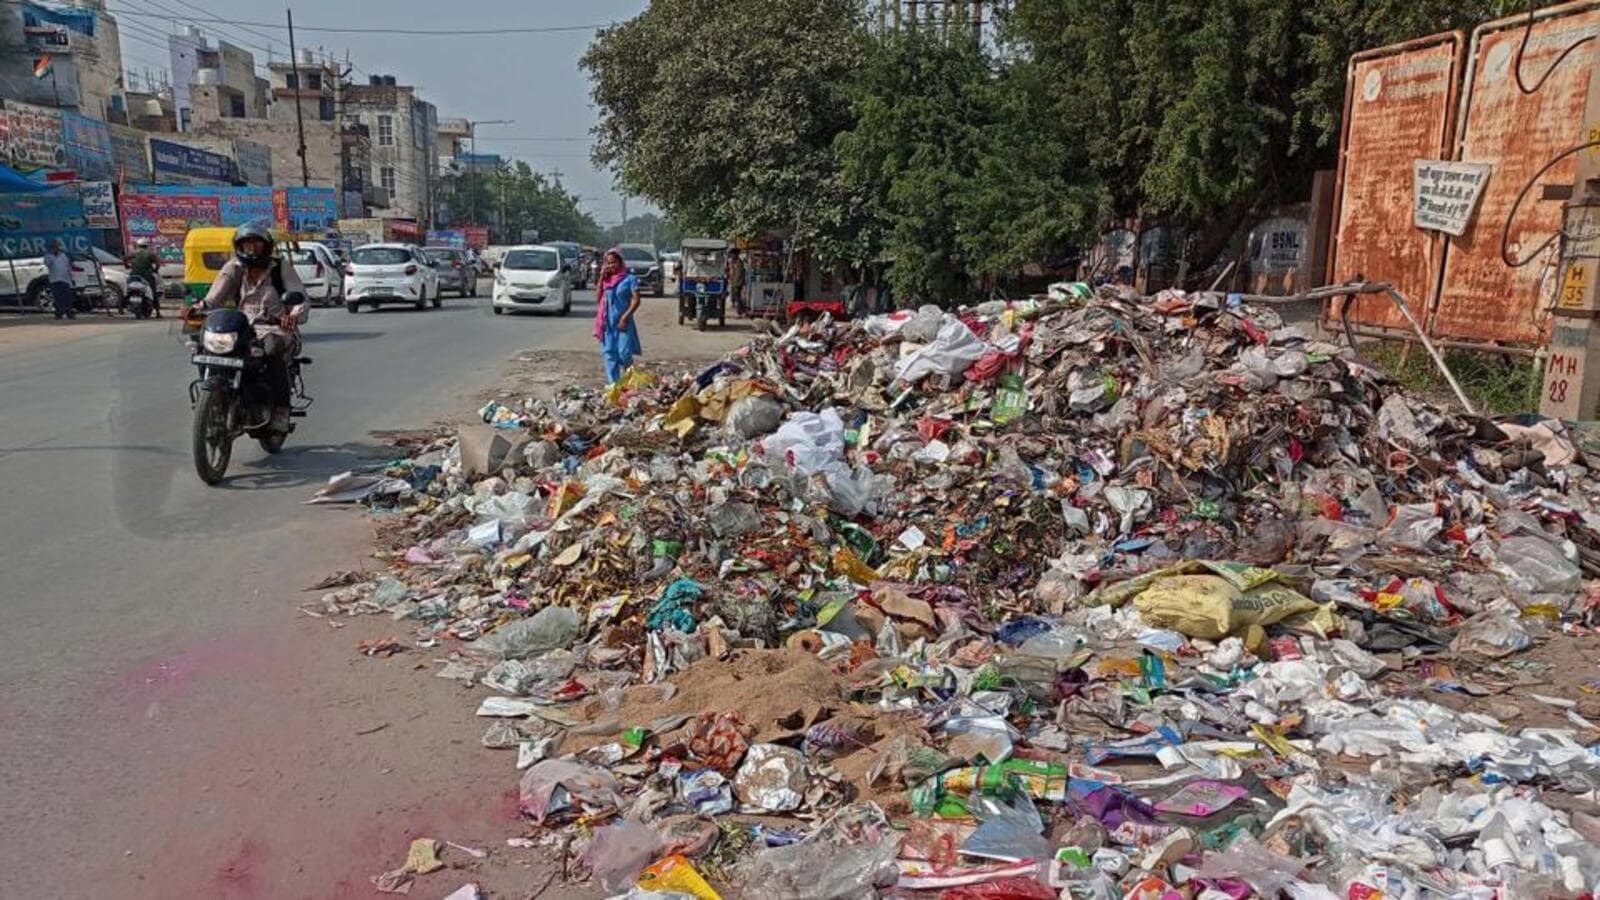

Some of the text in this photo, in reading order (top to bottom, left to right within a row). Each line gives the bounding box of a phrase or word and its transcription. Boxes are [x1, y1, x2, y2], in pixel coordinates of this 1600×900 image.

[1272, 231, 1299, 249] BSNL
[1572, 266, 1584, 281] H
[1565, 287, 1585, 301] 35
[1550, 379, 1568, 402] 28
